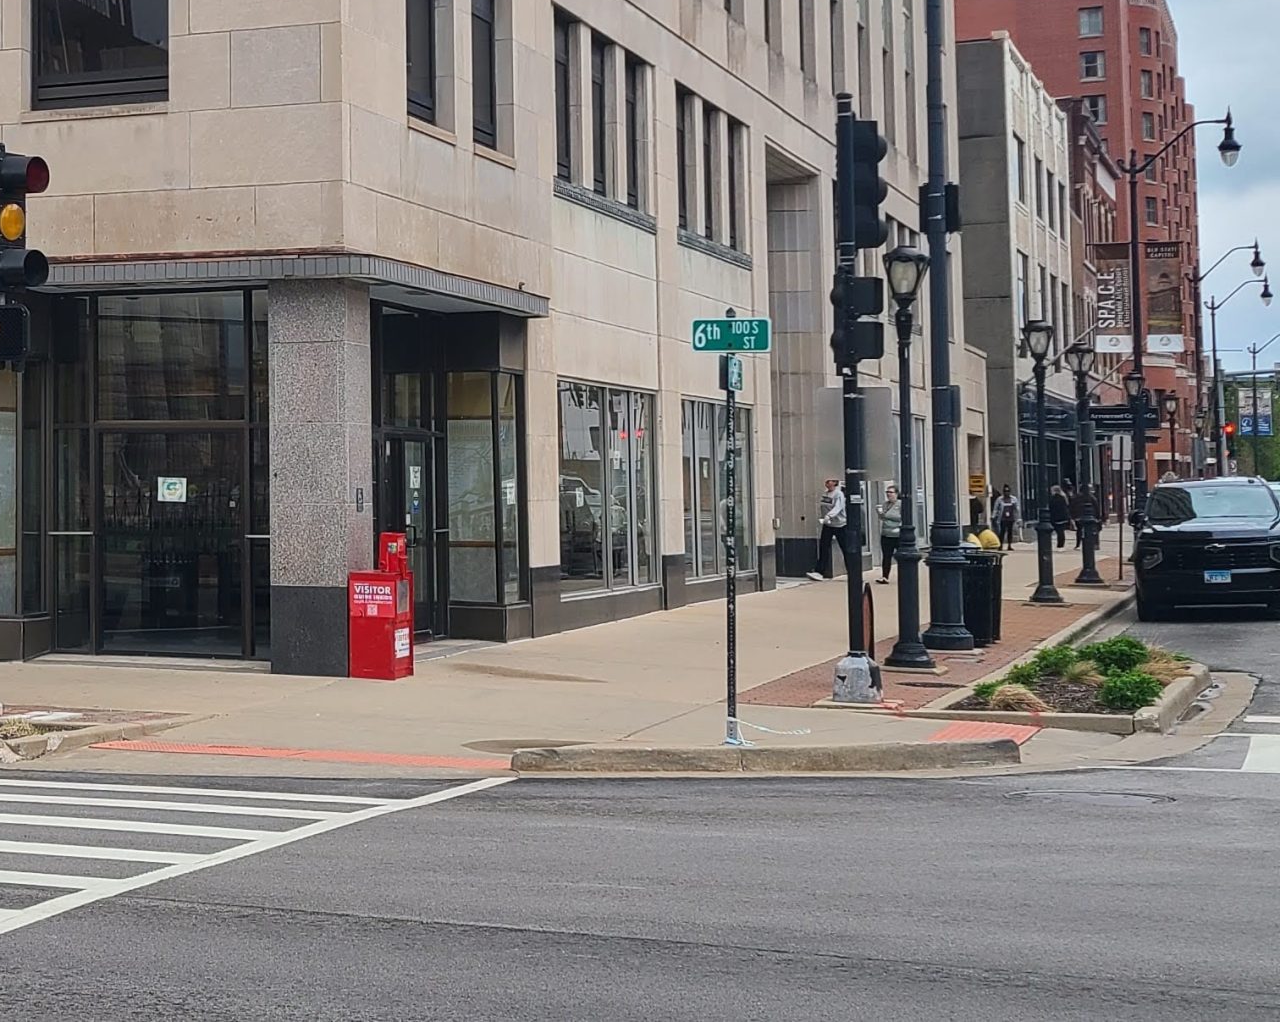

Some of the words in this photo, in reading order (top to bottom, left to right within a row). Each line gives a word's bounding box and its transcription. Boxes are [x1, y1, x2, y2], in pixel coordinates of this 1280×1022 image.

[694, 323, 721, 348] 6th
[731, 321, 750, 334] 100
[751, 321, 759, 334] S
[743, 336, 756, 349] ST
[354, 585, 392, 595] VISITOR
